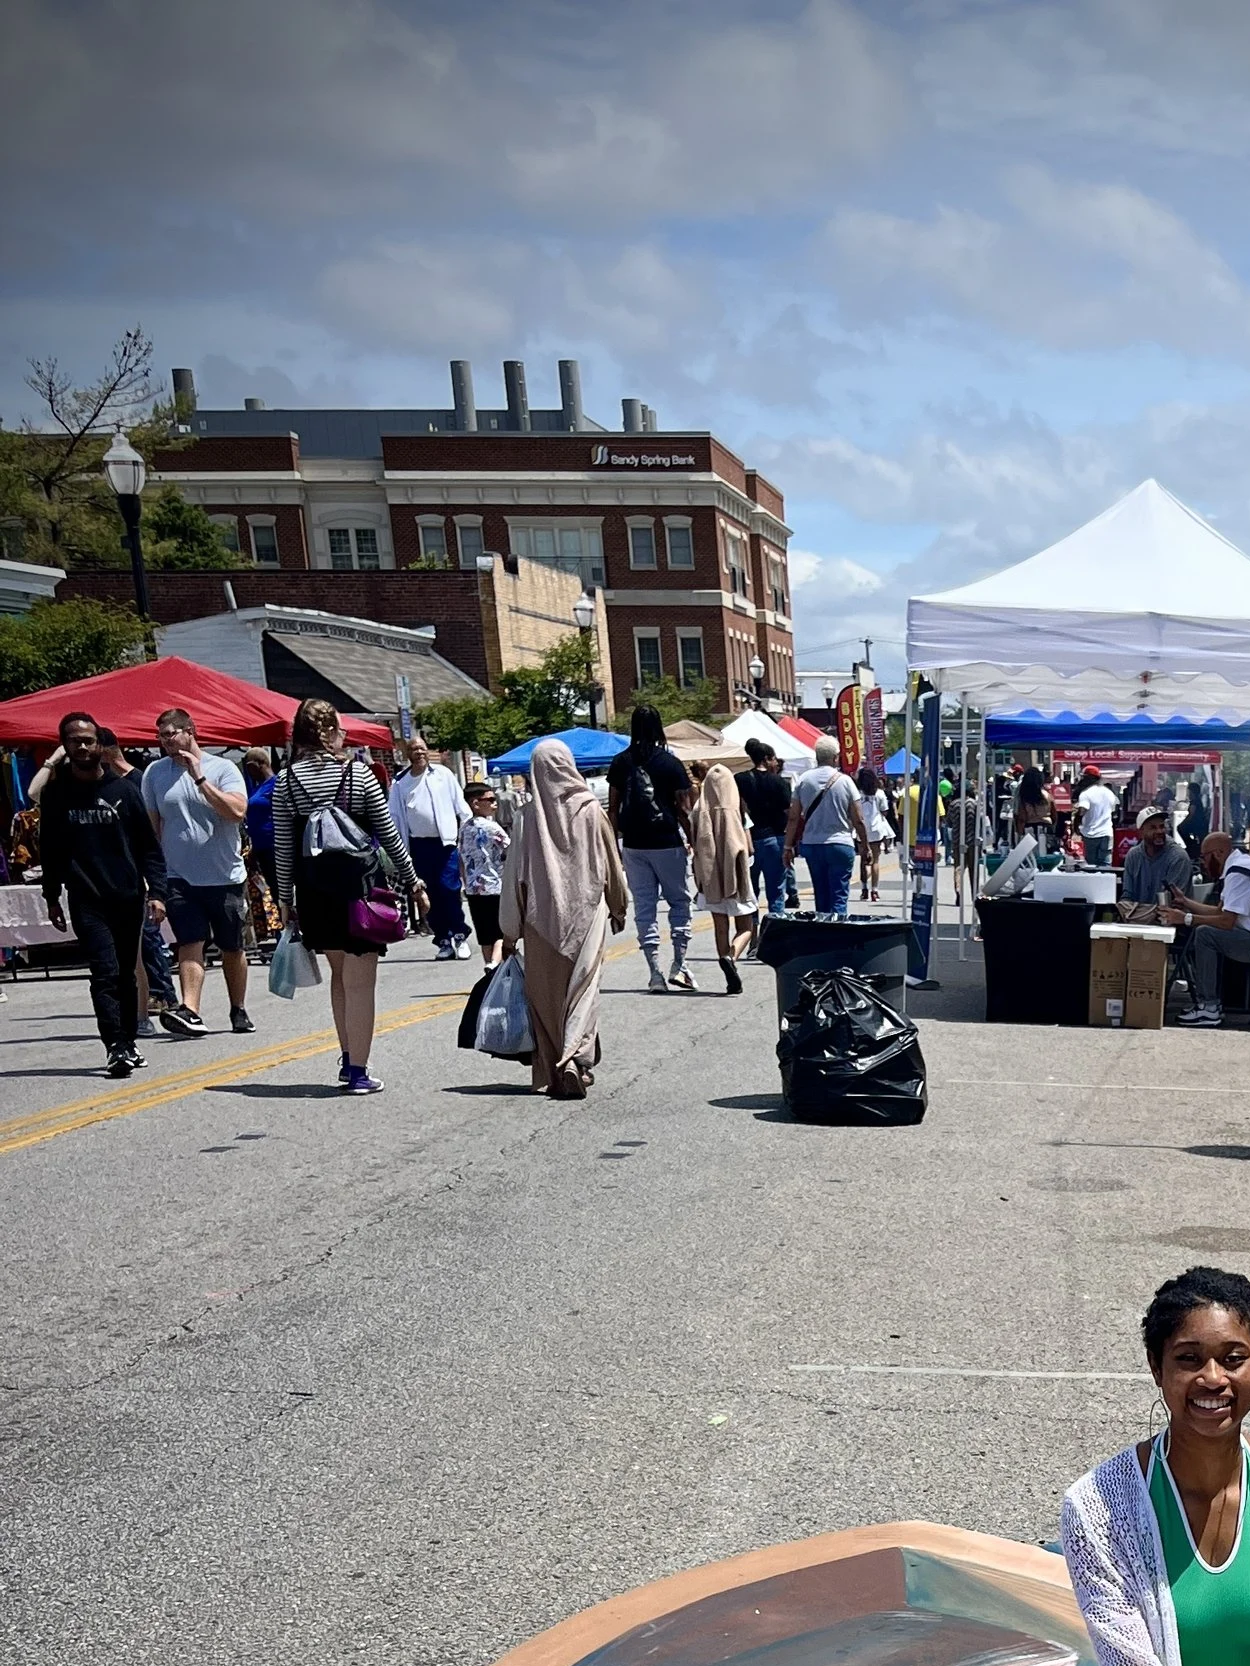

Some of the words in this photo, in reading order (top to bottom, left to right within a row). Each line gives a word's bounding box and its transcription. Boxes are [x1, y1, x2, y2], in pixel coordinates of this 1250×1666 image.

[611, 454, 640, 467] Sandy
[640, 454, 671, 467] Spring
[671, 454, 696, 465] Bank
[841, 701, 855, 765] BODY
[1064, 750, 1088, 760] Shop
[1118, 750, 1155, 761] Support
